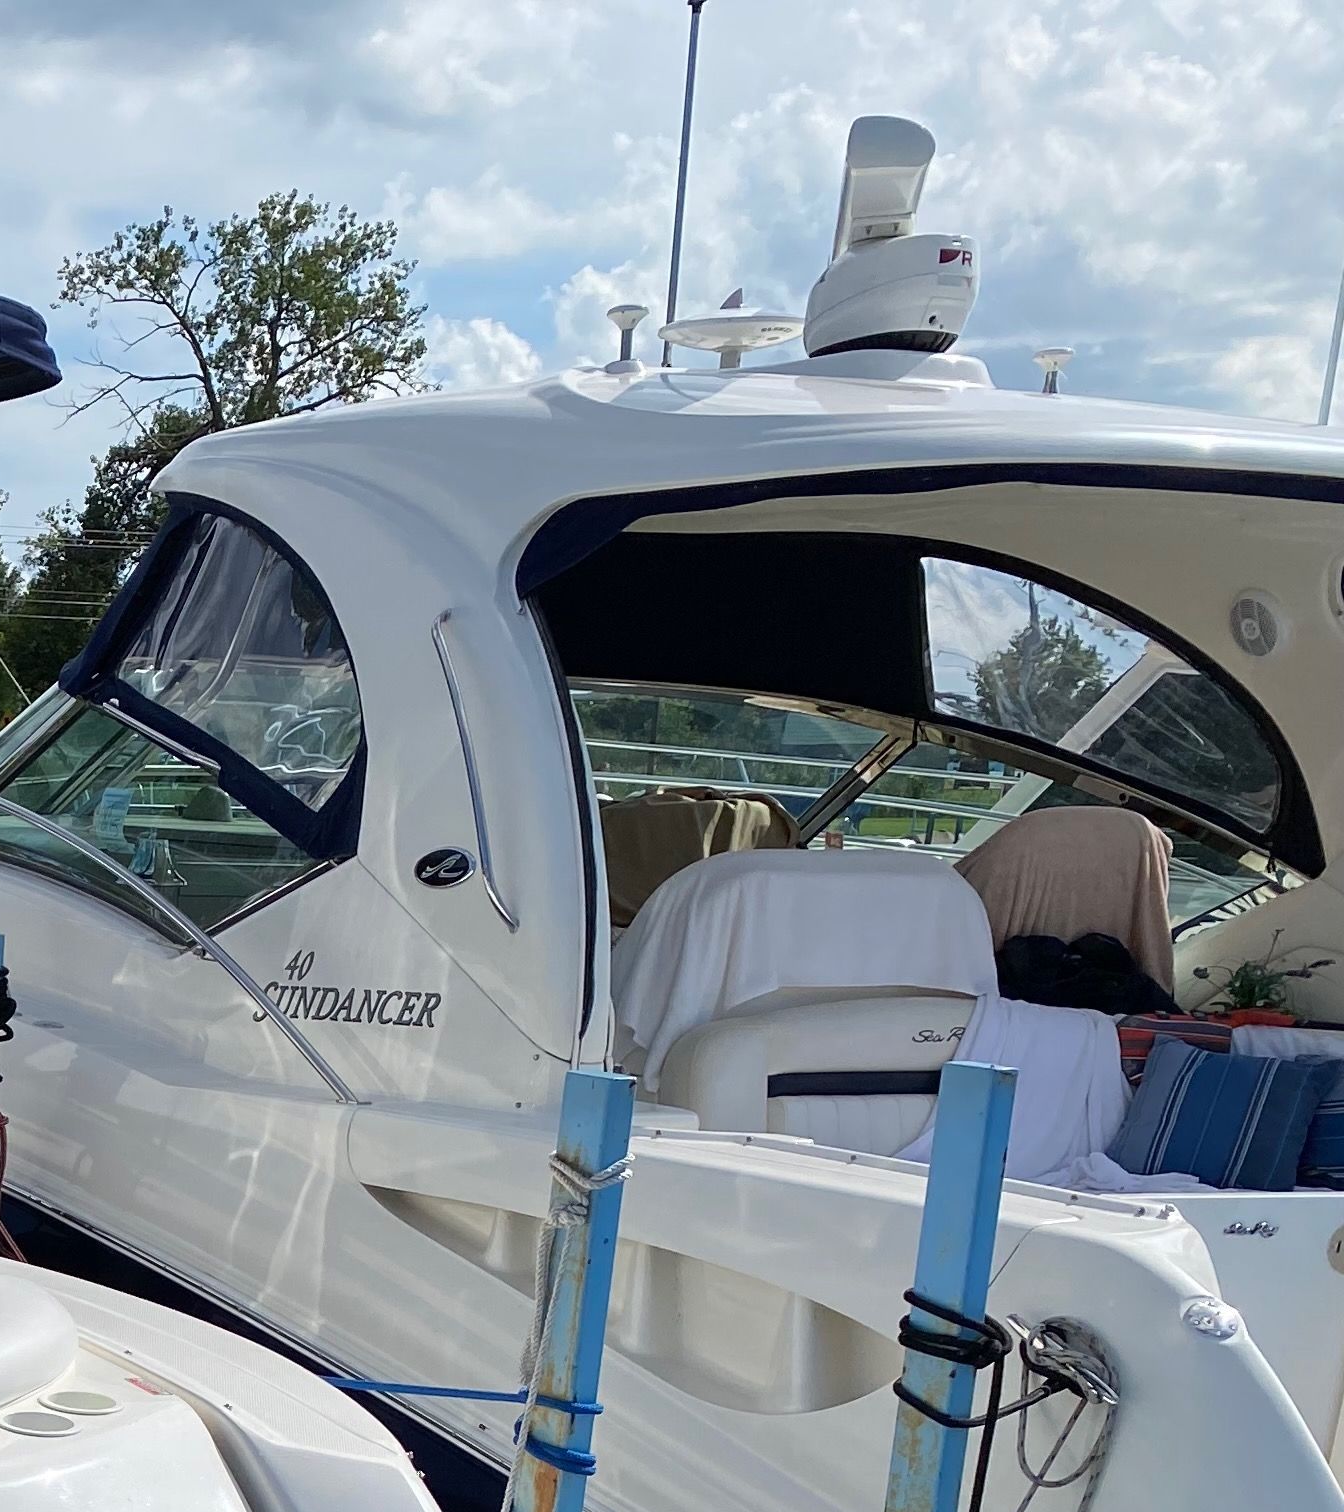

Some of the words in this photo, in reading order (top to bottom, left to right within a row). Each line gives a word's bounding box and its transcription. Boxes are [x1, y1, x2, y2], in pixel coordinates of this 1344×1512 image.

[284, 949, 316, 981] 40
[252, 980, 443, 1029] SUNDANCER
[911, 1029, 945, 1043] Sea
